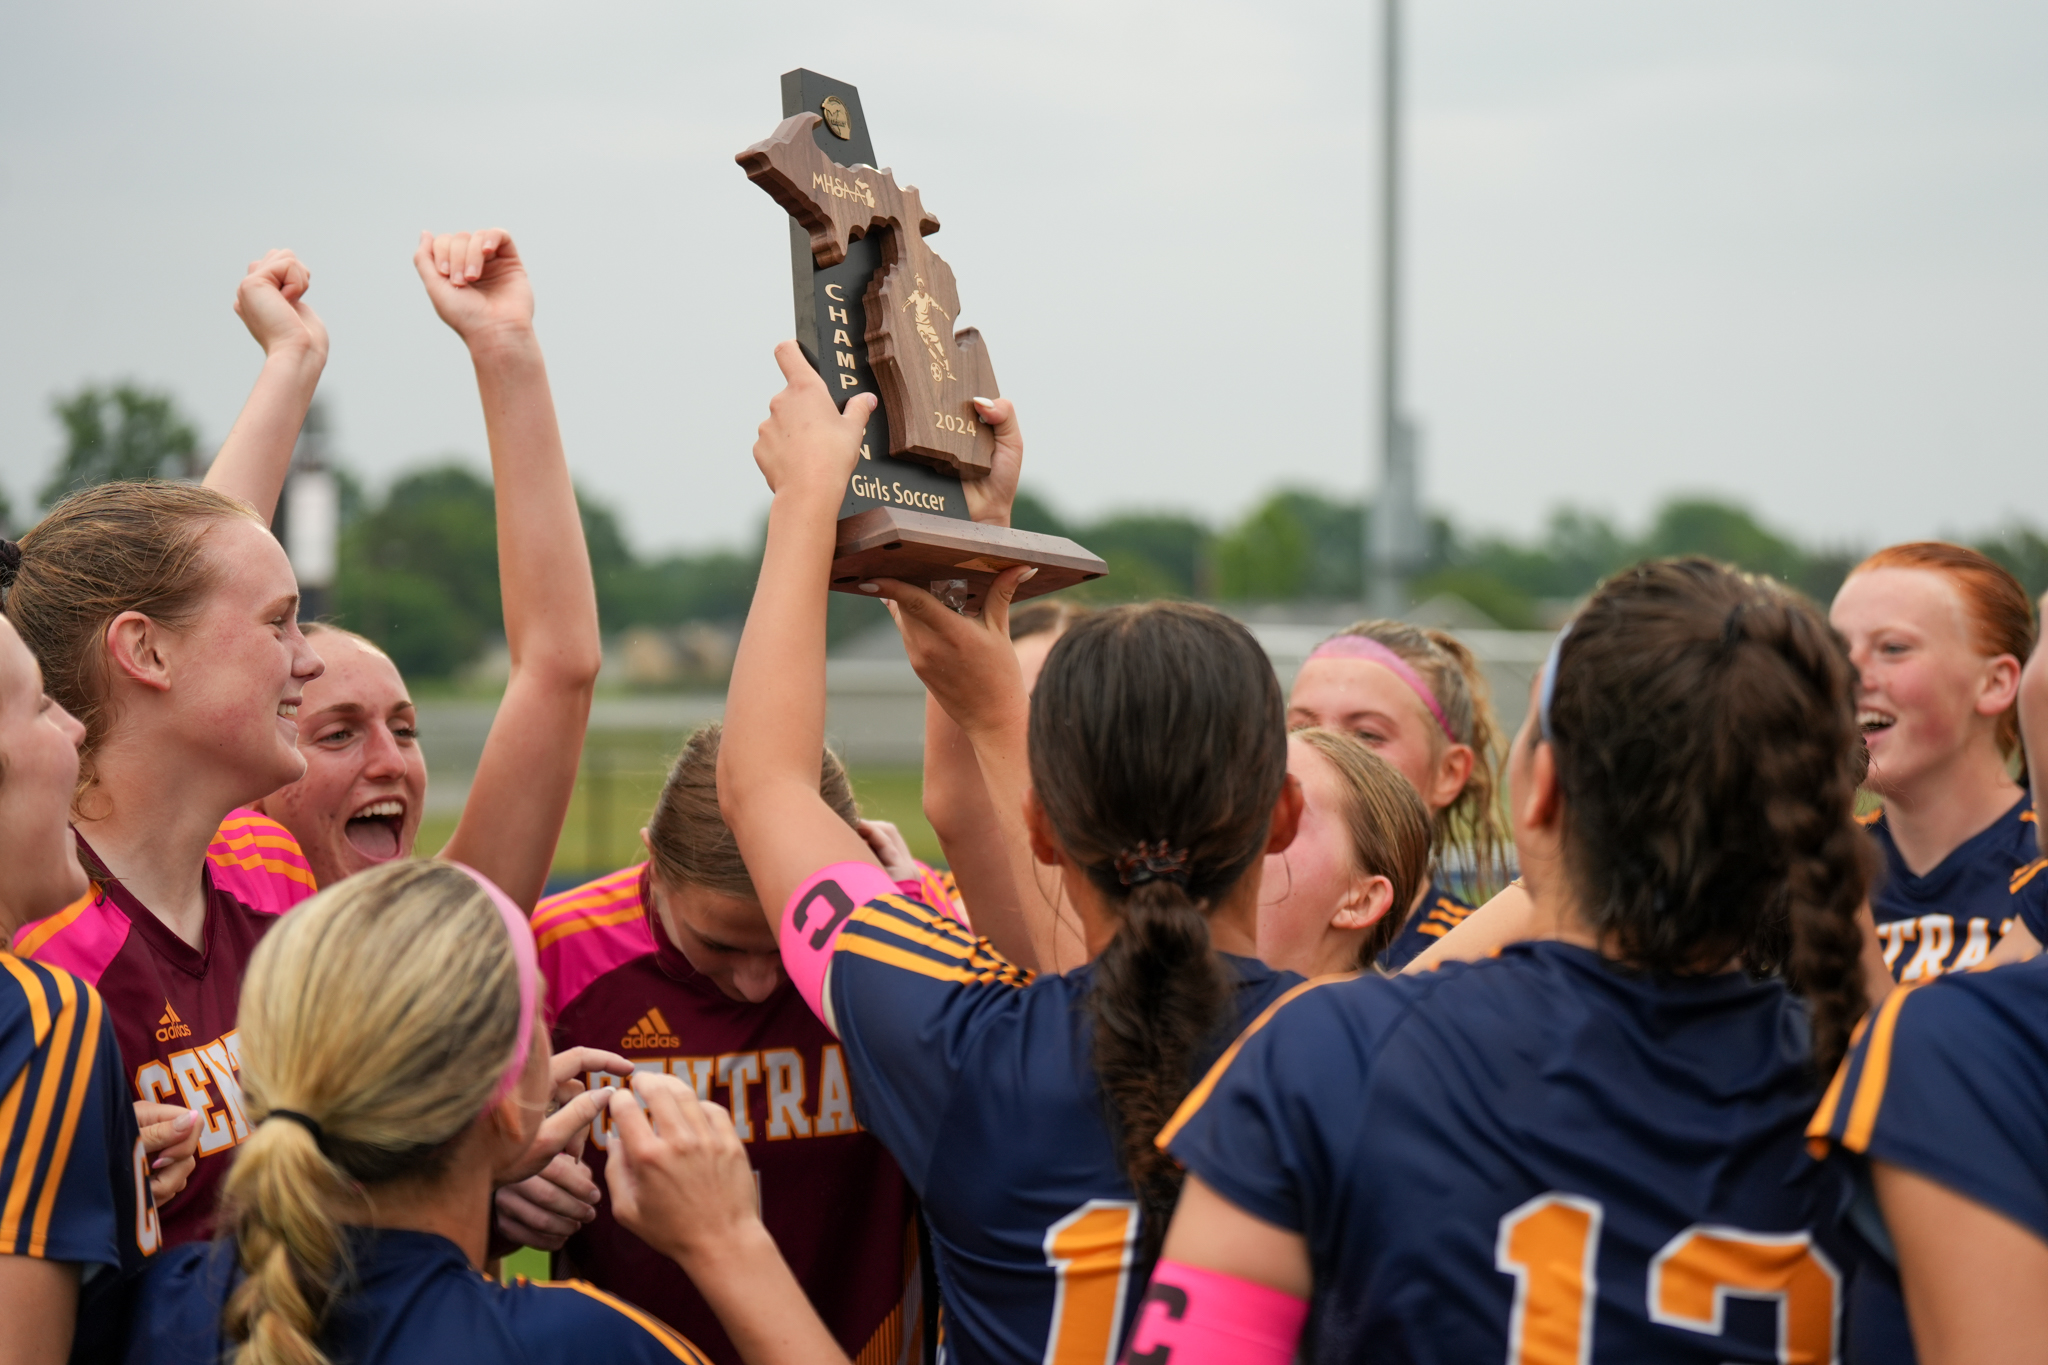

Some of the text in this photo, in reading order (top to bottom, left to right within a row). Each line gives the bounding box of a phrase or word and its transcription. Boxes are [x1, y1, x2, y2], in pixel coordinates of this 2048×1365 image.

[812, 171, 867, 206] MHSAA
[825, 283, 871, 461] CHAMPN
[934, 411, 977, 437] 2024
[851, 474, 945, 511] Girls Soccer
[793, 879, 855, 951] C
[1876, 913, 2014, 983] TRA
[621, 1033, 680, 1049] adidas
[1043, 1198, 1139, 1365] 1
